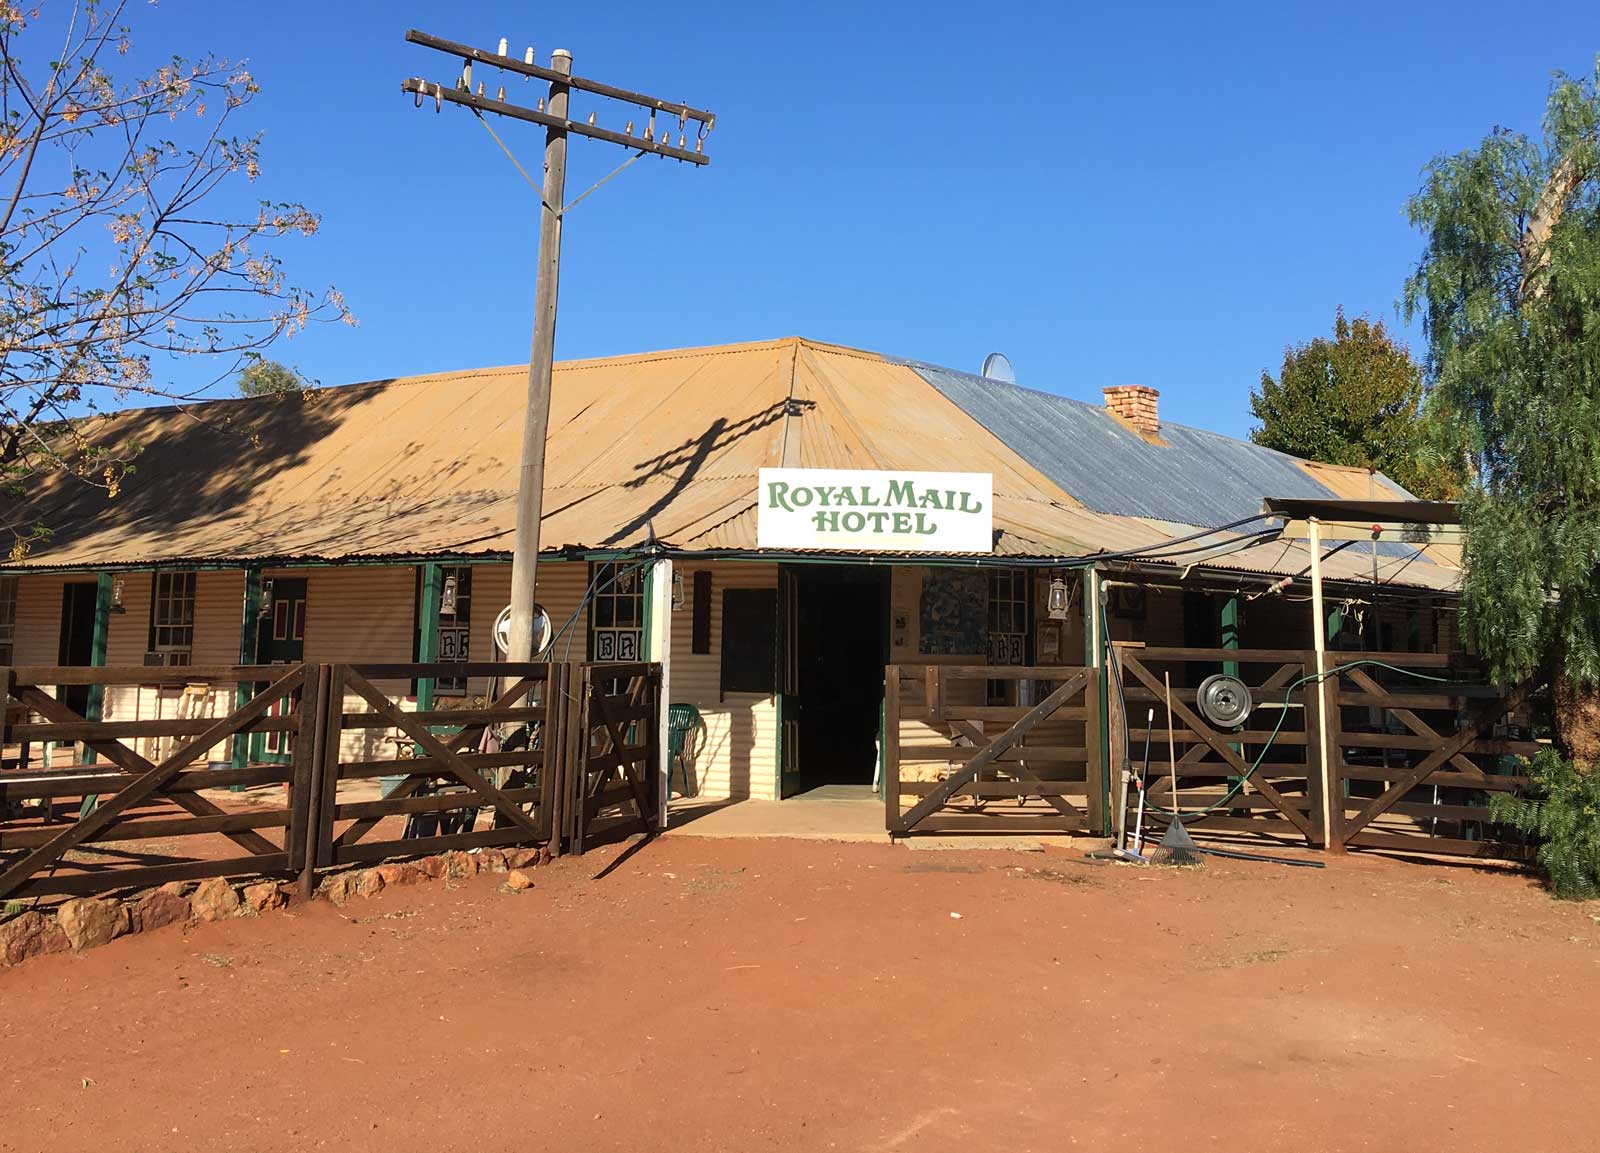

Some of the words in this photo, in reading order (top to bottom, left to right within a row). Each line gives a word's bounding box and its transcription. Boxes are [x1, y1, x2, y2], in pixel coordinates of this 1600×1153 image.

[767, 481, 881, 513] ROYAL
[883, 479, 983, 514] MAIL
[811, 510, 938, 535] HOTEL
[599, 636, 634, 657] BA
